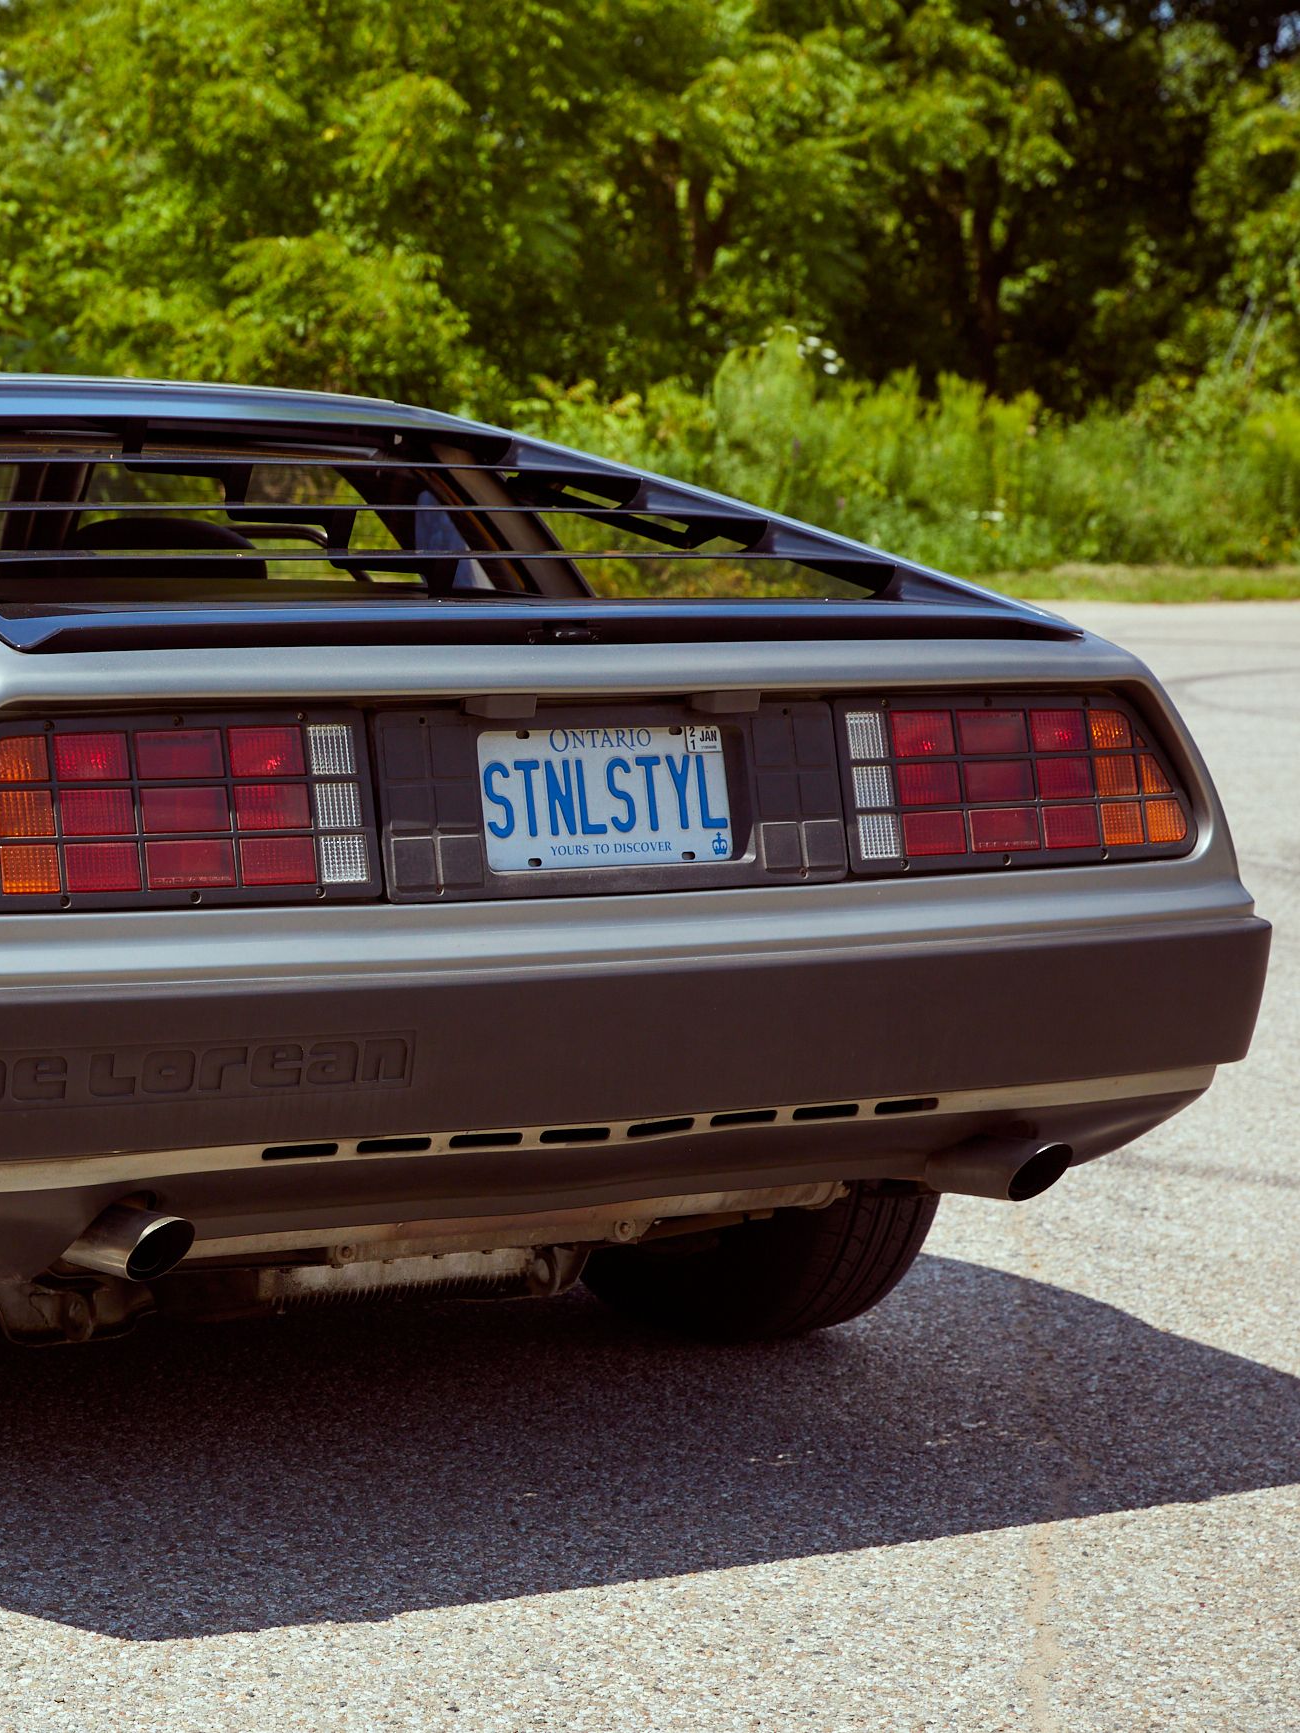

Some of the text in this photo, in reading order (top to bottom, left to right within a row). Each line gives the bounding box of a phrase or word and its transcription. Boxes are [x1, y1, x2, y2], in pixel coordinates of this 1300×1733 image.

[549, 729, 650, 752] ONTARIO
[699, 730, 717, 742] JAN
[484, 755, 728, 838] STNLSTYL
[550, 840, 672, 857] YOURS TO DISCOVER
